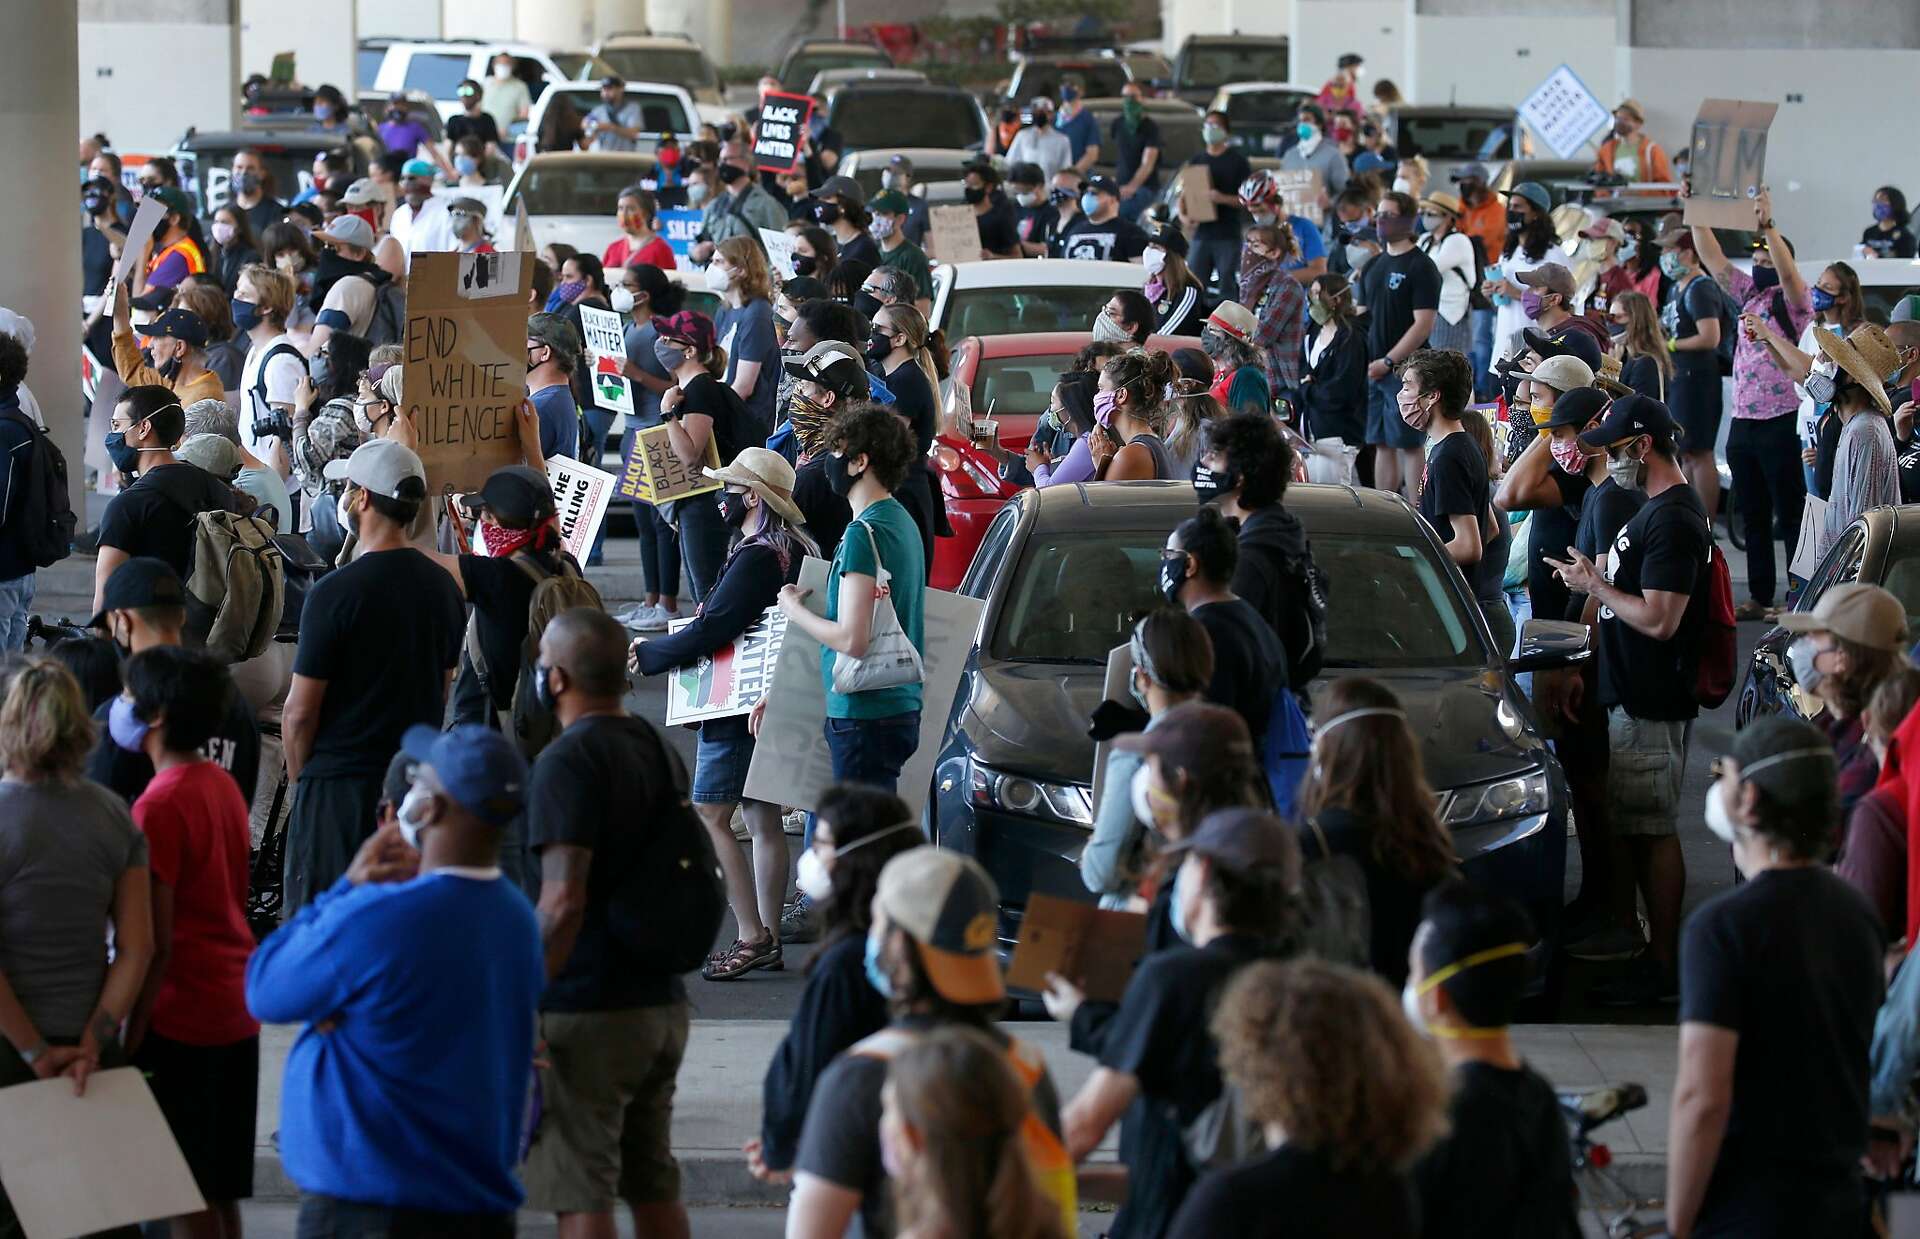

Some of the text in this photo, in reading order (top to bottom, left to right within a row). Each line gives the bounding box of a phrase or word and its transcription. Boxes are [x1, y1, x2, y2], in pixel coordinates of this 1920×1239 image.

[761, 122, 792, 140] LIVES
[762, 104, 799, 124] BLACK
[754, 139, 795, 158] MATTER
[408, 316, 457, 363] END
[585, 326, 624, 353] MATTER
[429, 363, 510, 399] WHITE
[620, 460, 644, 497] BLACK
[646, 441, 671, 491] BLACK
[553, 471, 571, 502] THE
[560, 479, 589, 540] KILLING
[768, 611, 787, 656] BLACK
[738, 612, 769, 709] MATTER
